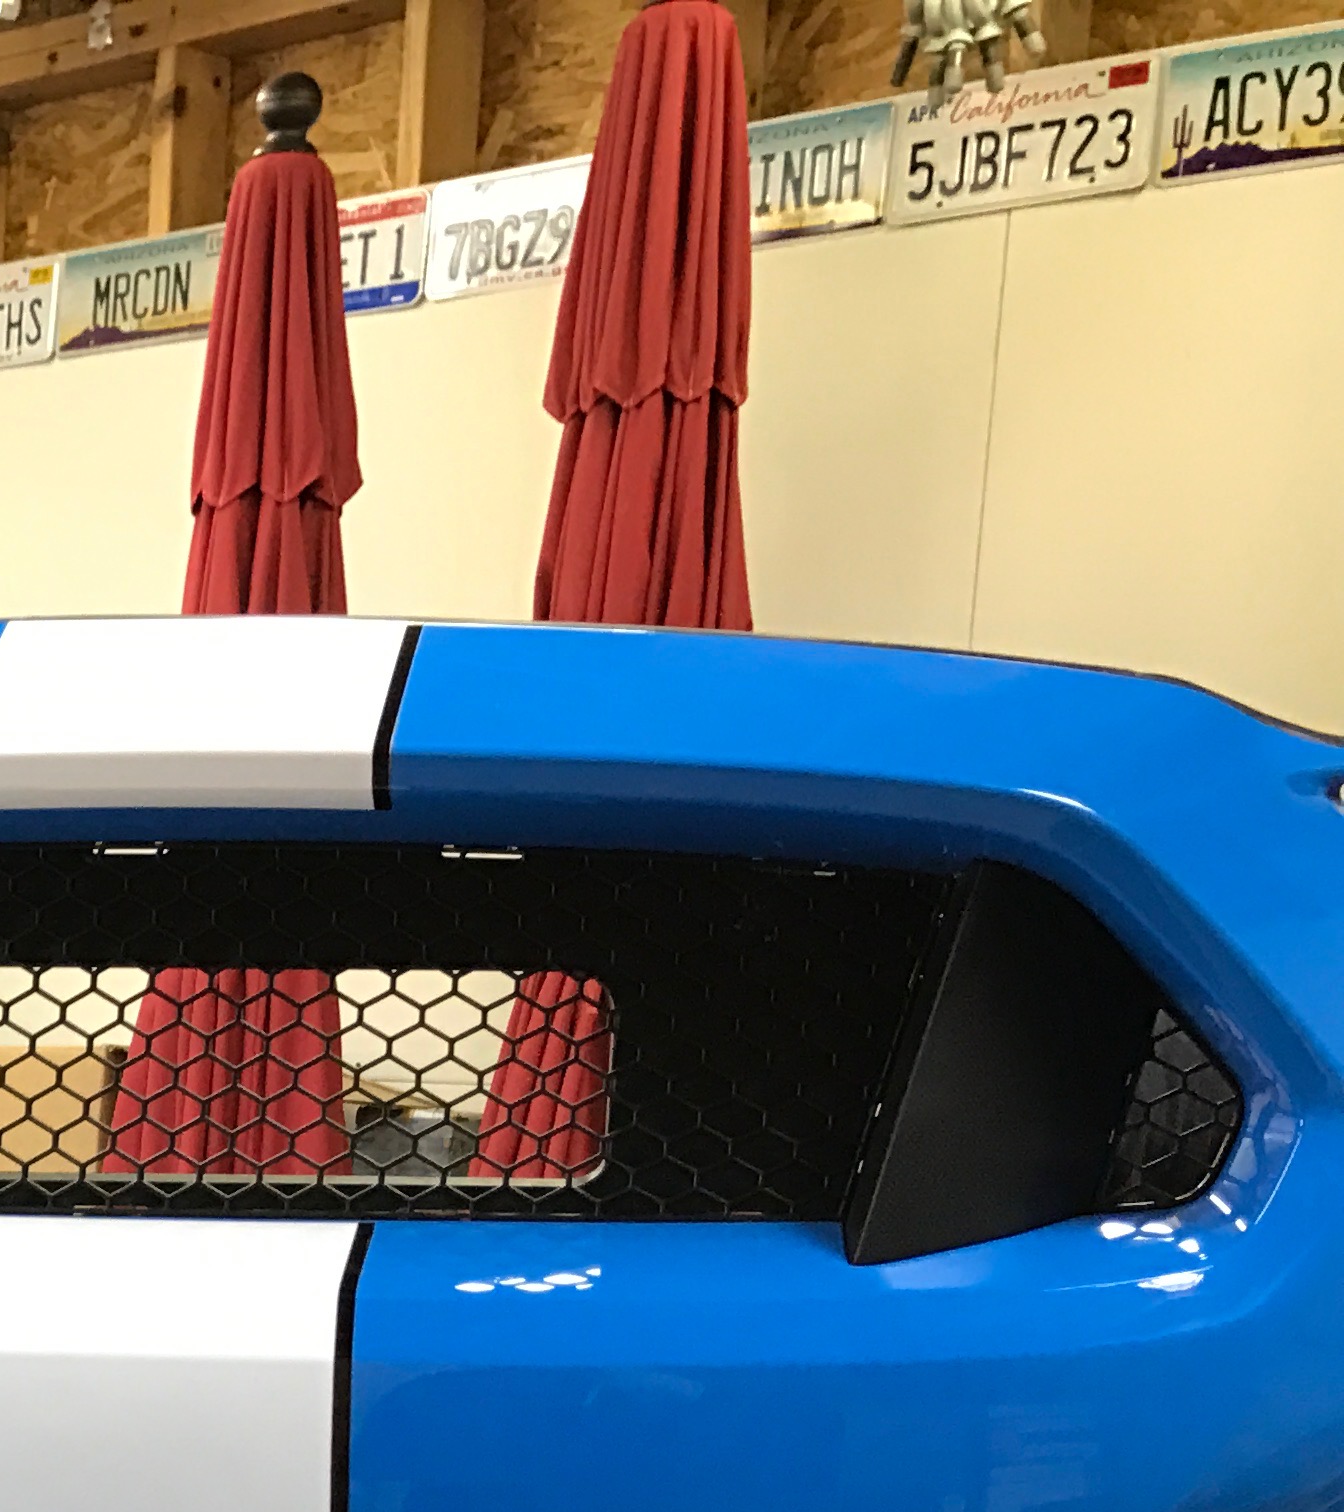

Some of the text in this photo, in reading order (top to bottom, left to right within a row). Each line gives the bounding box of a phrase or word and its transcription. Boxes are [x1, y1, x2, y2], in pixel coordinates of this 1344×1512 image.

[950, 82, 1106, 124] California
[1204, 60, 1344, 142] ACY3
[749, 137, 863, 217] INOH
[907, 108, 1134, 201] 5JBF723
[92, 260, 192, 327] MRCDN
